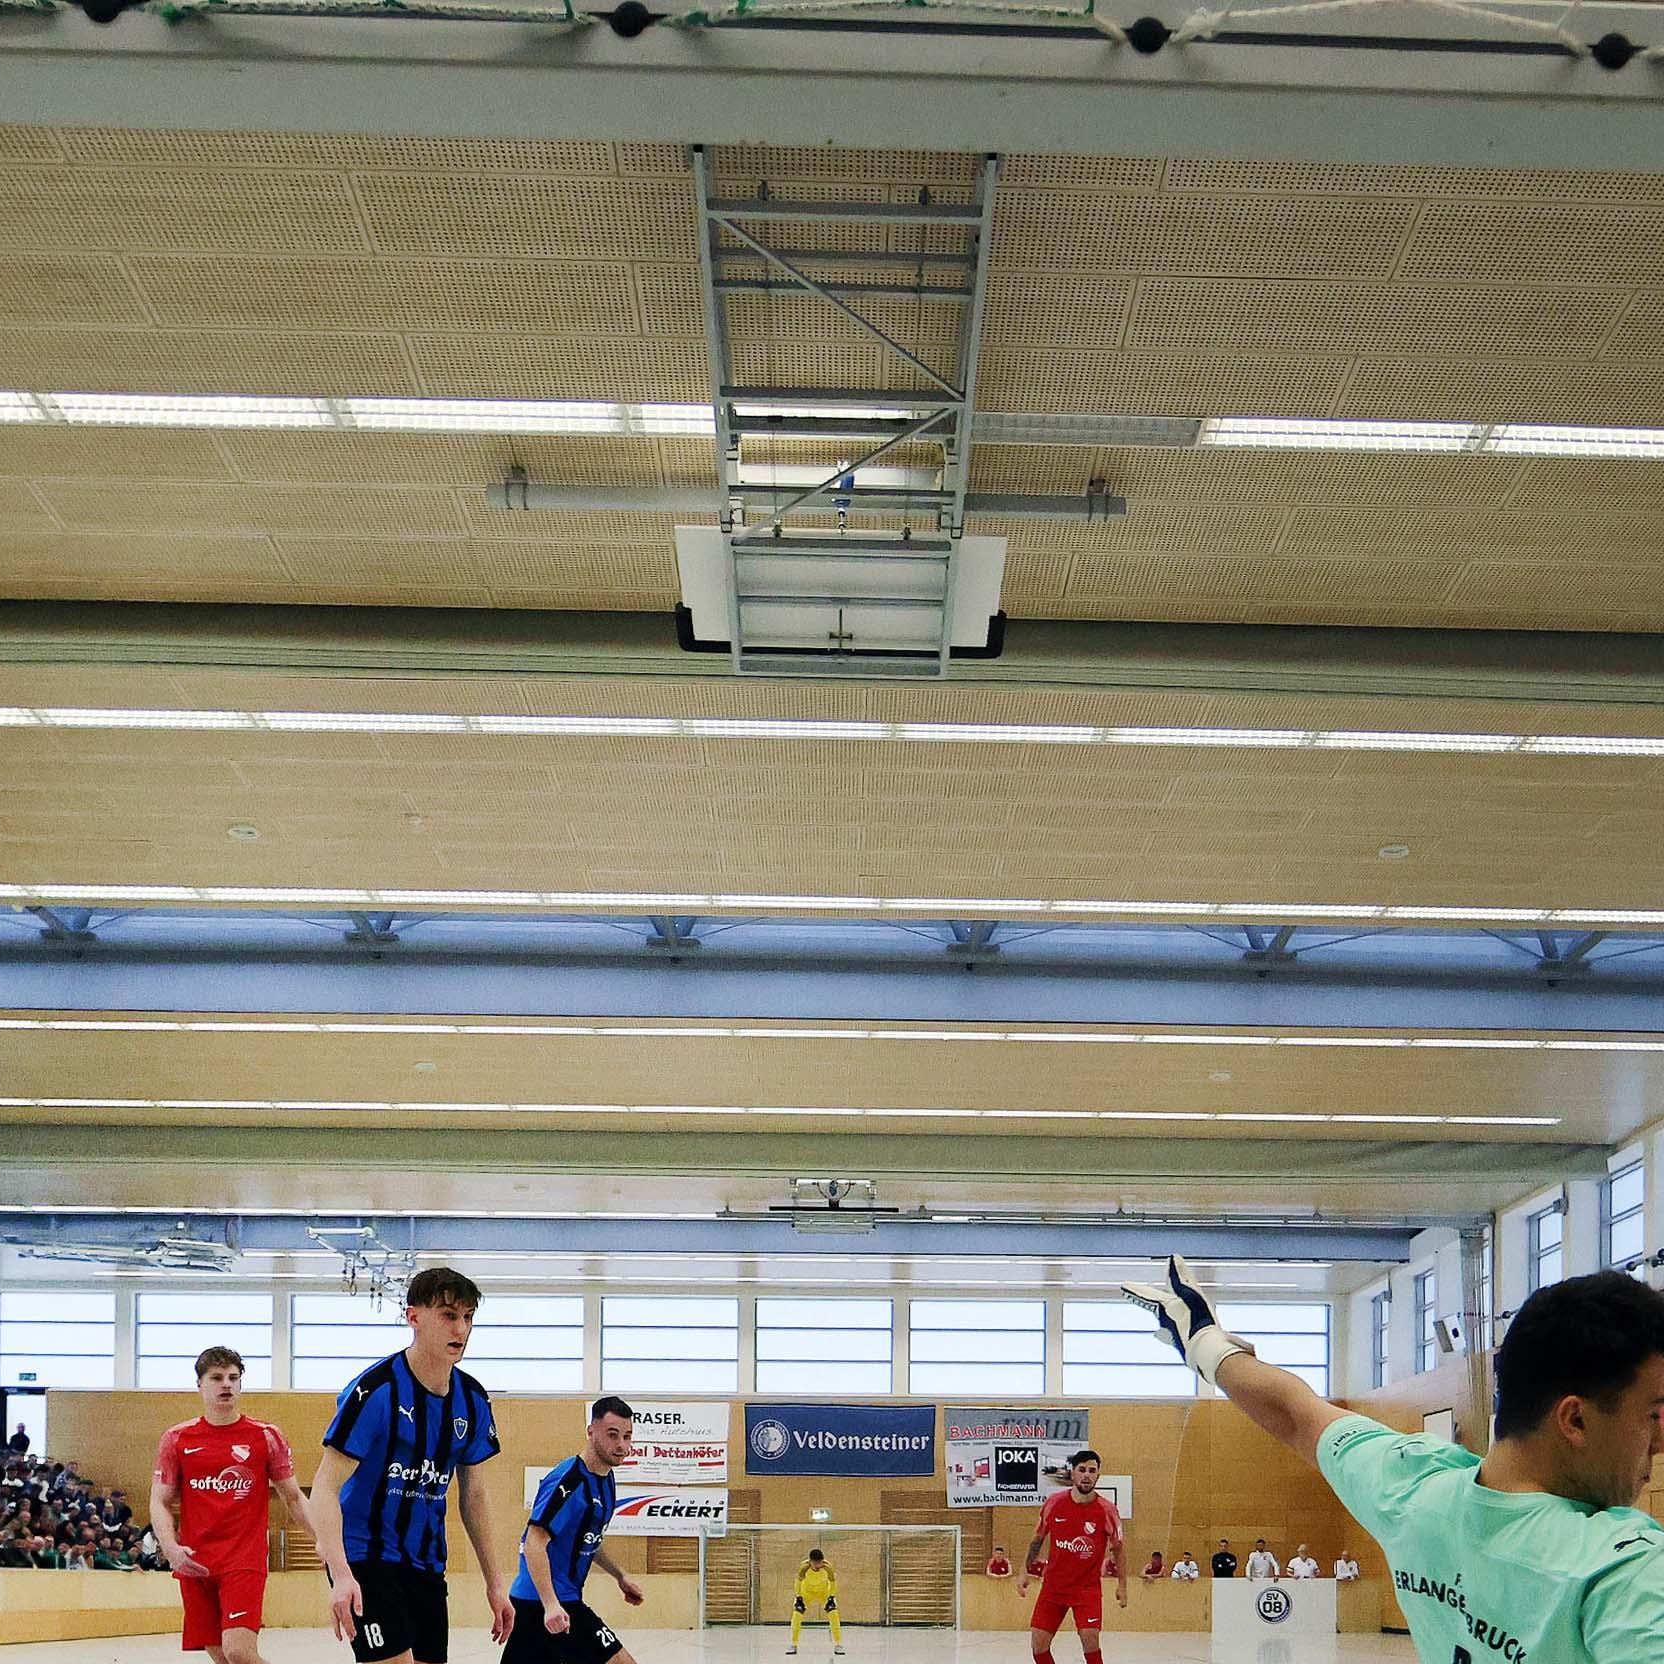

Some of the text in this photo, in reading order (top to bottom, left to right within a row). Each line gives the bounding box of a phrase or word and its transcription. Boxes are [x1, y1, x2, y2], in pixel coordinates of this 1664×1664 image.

[633, 1411, 686, 1425] RASER.
[949, 1424, 1047, 1439] BACHMANN
[793, 1430, 930, 1450] Veldensteiner
[997, 1449, 1036, 1465] JOKA
[388, 1462, 419, 1480] Der
[647, 1505, 724, 1518] ECKERT
[1266, 1593, 1279, 1601] SV
[1262, 1601, 1283, 1613] 08
[364, 1622, 385, 1649] 18
[596, 1626, 616, 1648] 26
